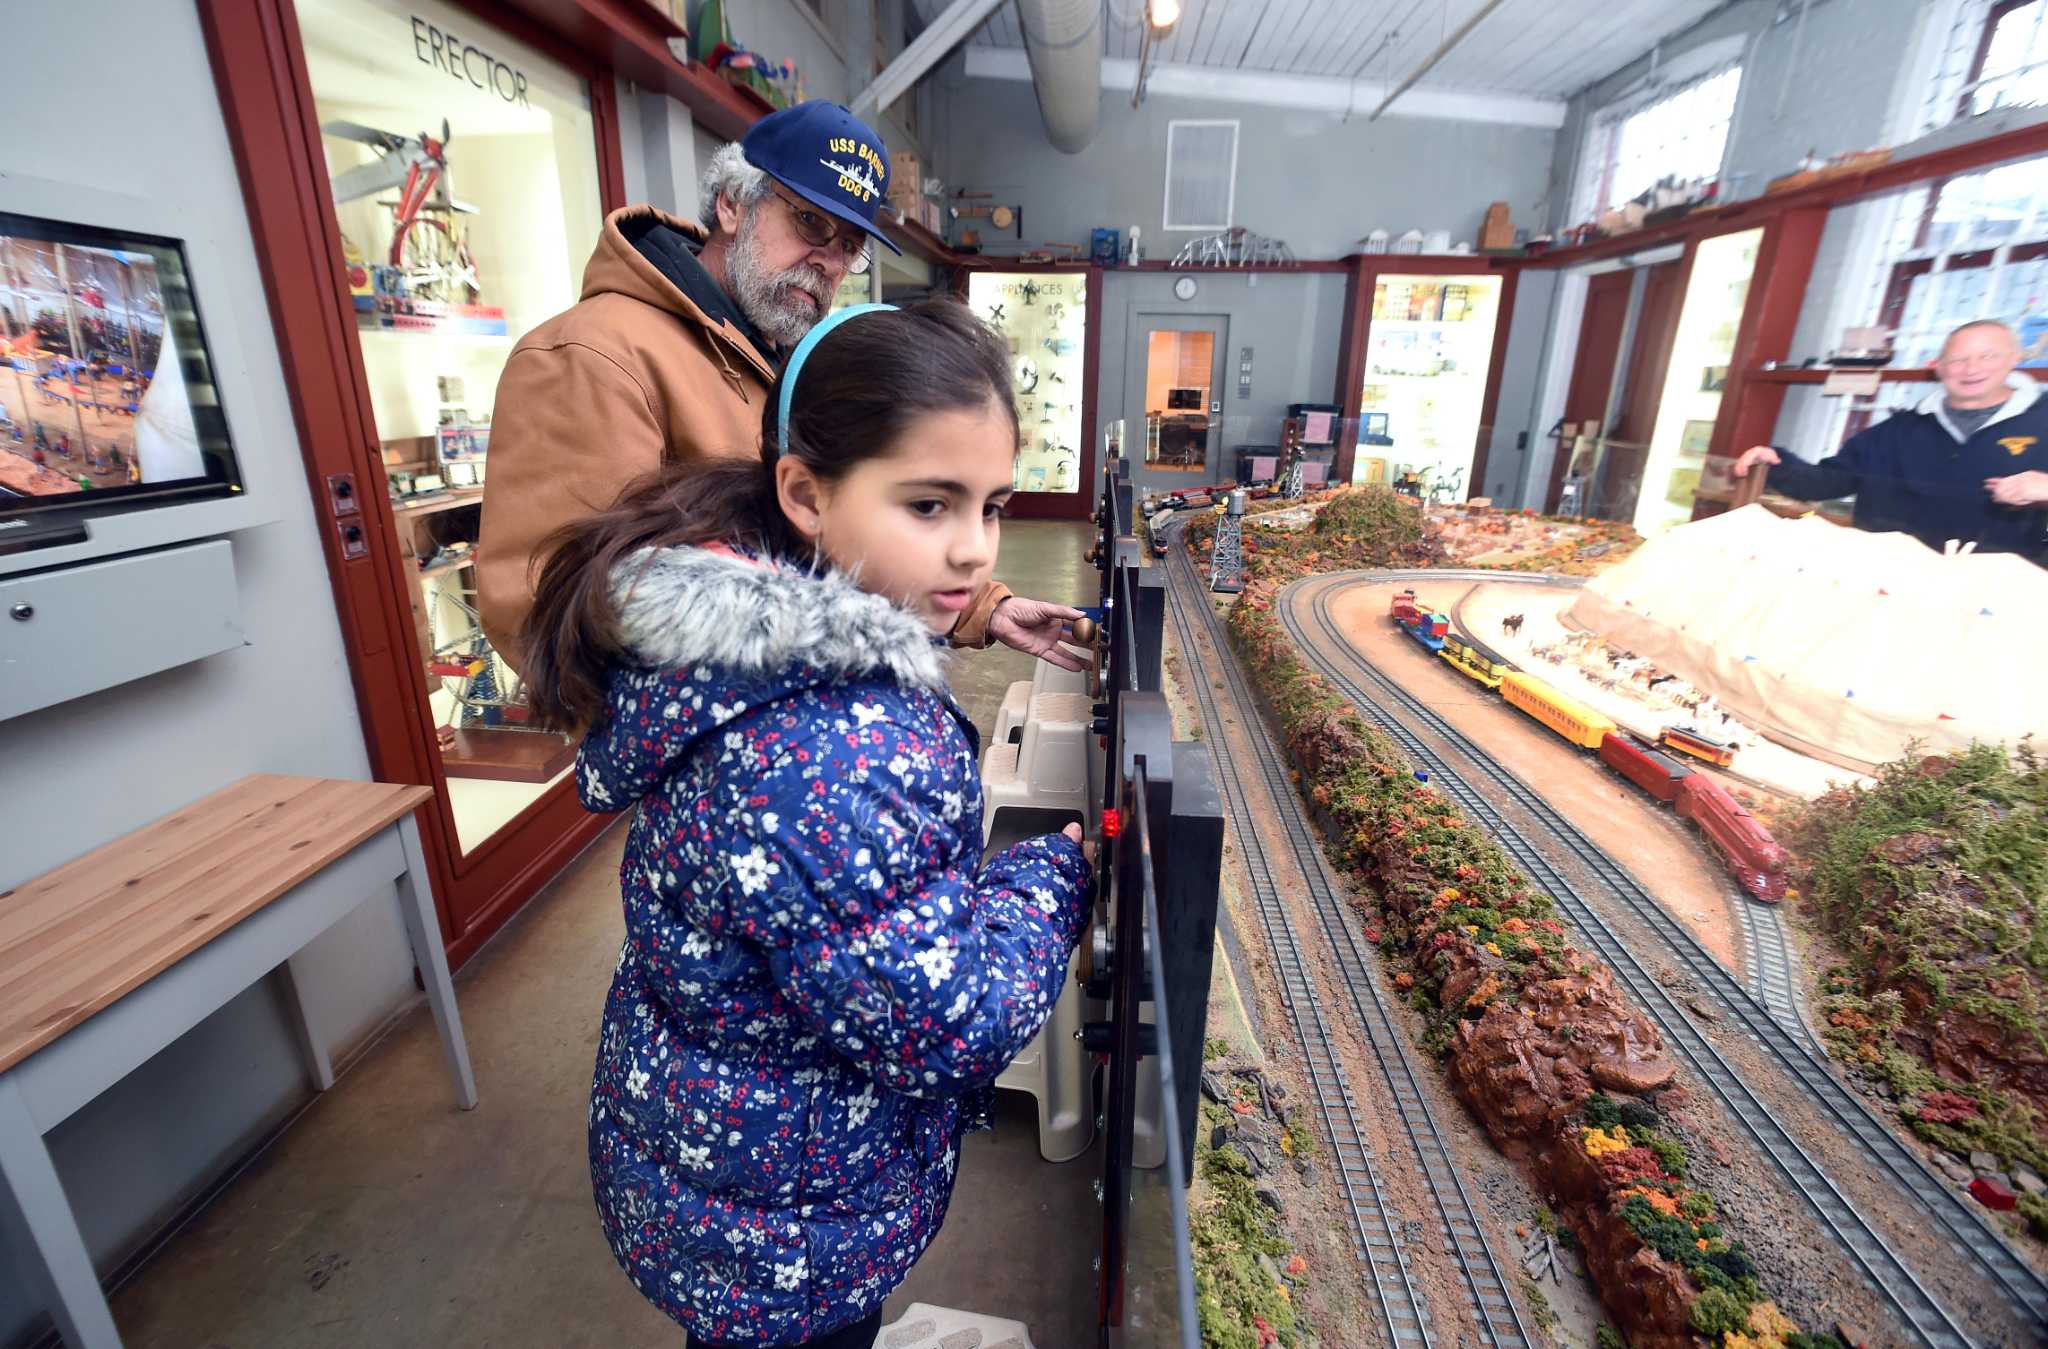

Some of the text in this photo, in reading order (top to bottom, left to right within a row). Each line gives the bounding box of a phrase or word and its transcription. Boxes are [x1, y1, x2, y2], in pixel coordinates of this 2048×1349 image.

[411, 15, 530, 110] ERECTOR
[829, 138, 856, 153] USS
[838, 174, 871, 203] DDG 6
[994, 284, 1063, 295] APPLINCES
